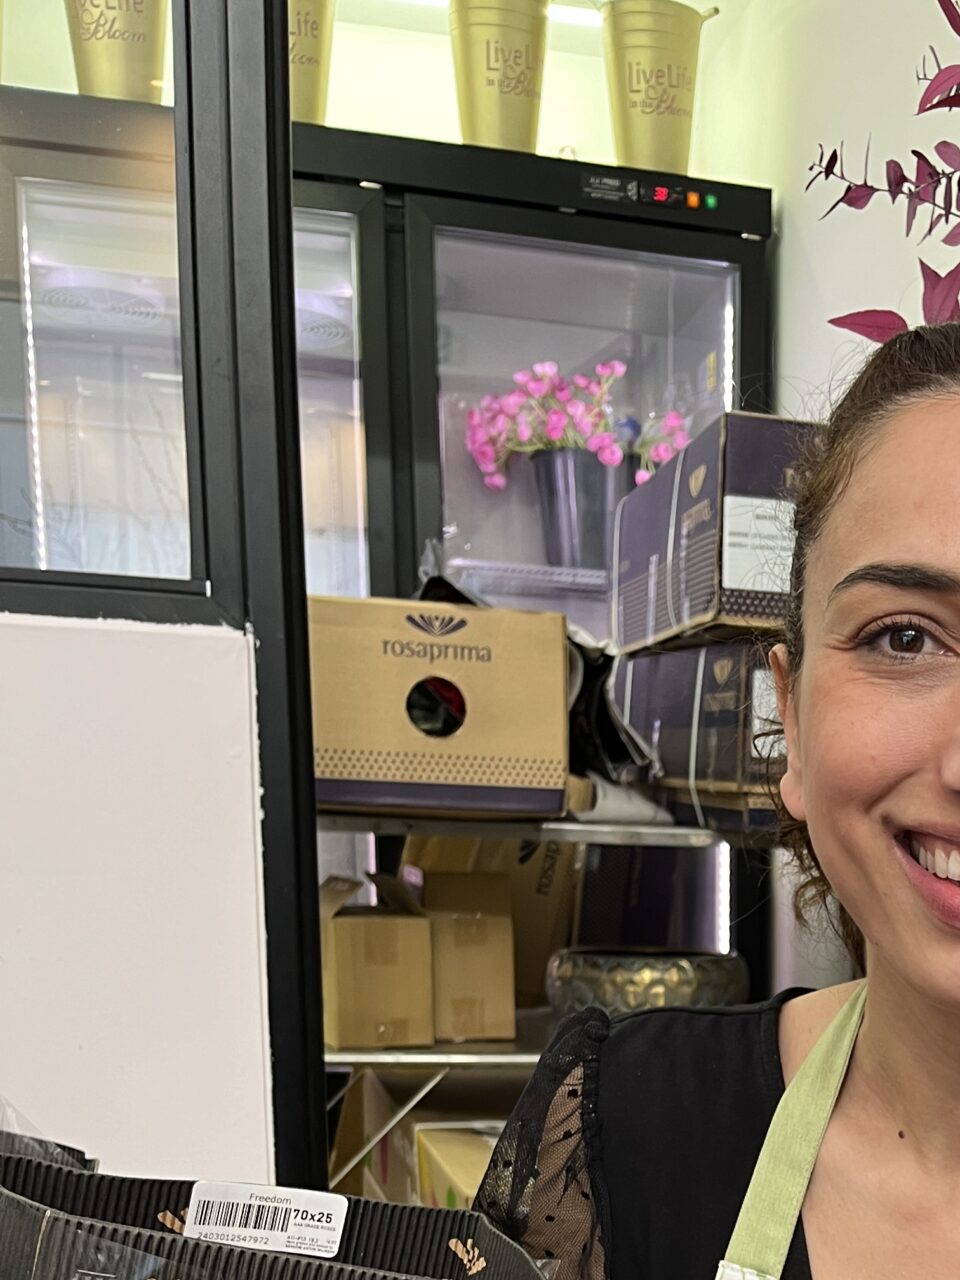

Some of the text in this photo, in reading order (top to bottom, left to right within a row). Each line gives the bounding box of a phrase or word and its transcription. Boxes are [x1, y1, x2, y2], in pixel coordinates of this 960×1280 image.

[382, 640, 492, 664] rosaprima
[249, 1193, 292, 1206] Freedom
[293, 1208, 334, 1224] 70x25
